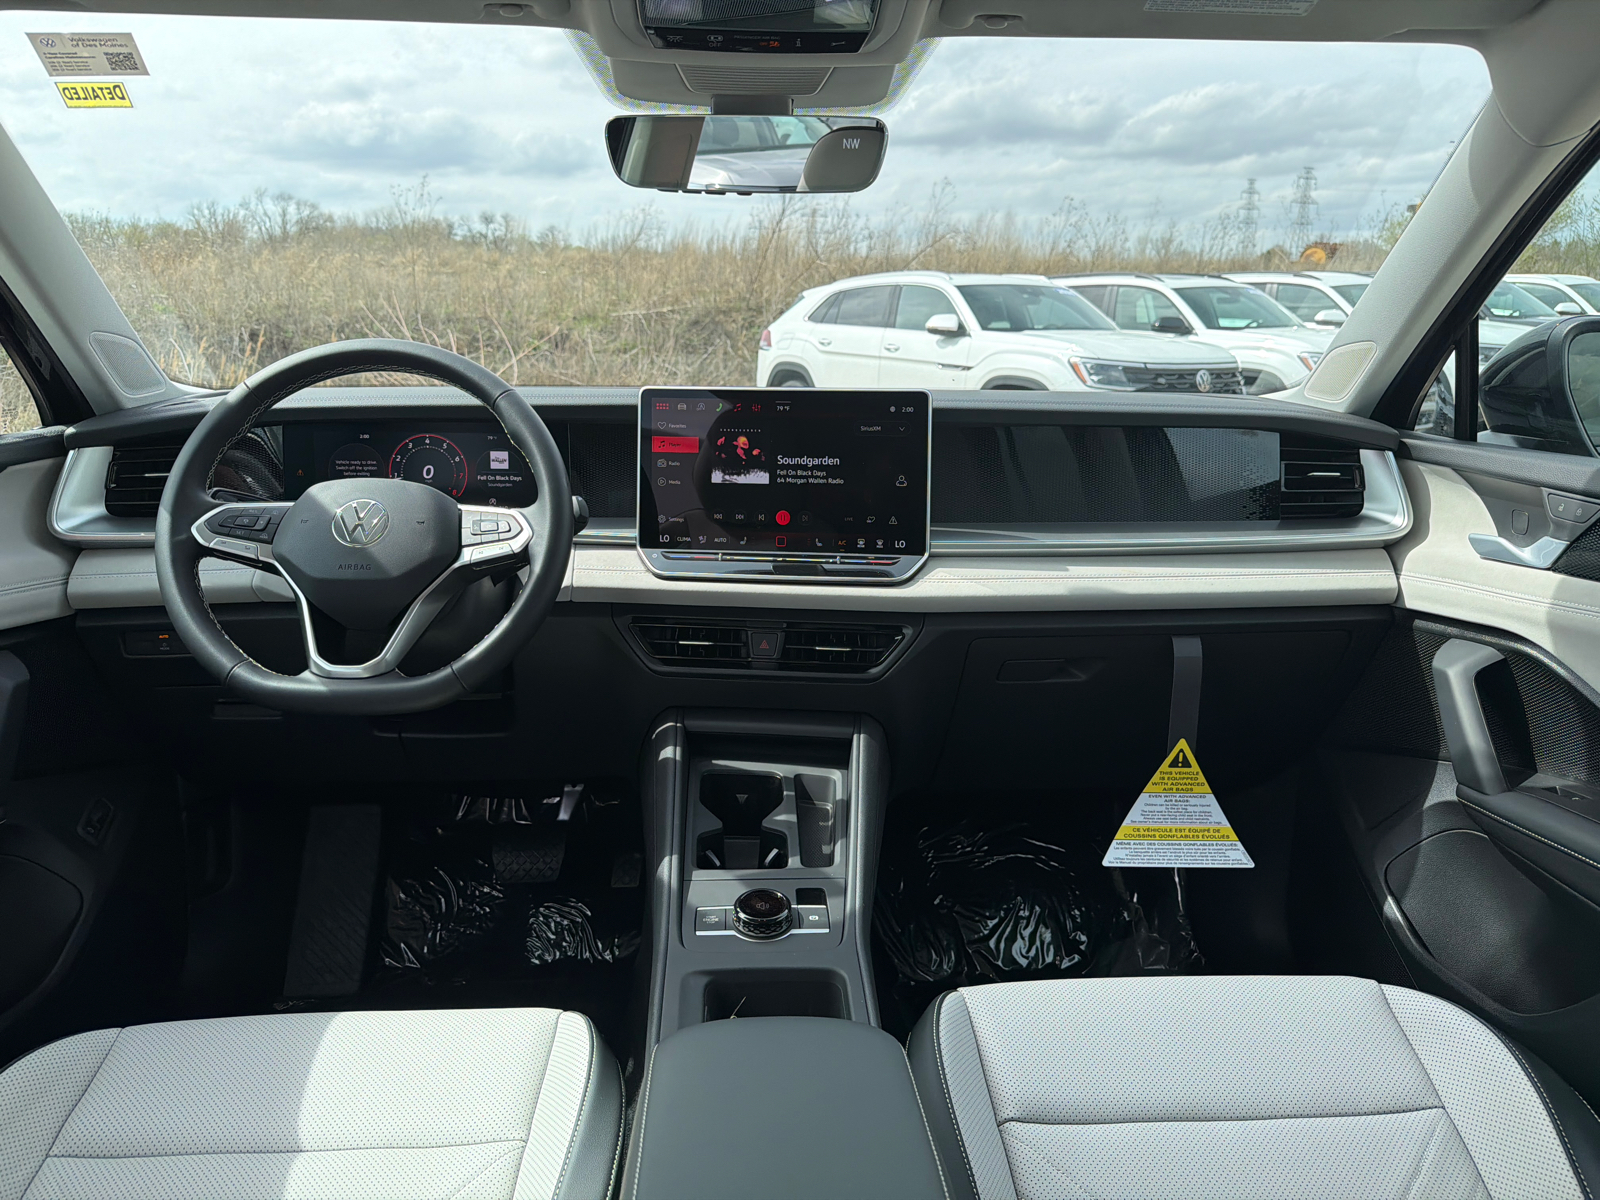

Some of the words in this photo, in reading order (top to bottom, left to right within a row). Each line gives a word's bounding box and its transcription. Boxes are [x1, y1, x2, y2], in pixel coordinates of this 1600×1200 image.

[842, 138, 861, 149] NW
[777, 455, 840, 467] Soundgarden
[422, 465, 434, 479] 0
[659, 534, 670, 542] LO
[895, 540, 906, 548] LO
[337, 563, 372, 571] AIRBAG
